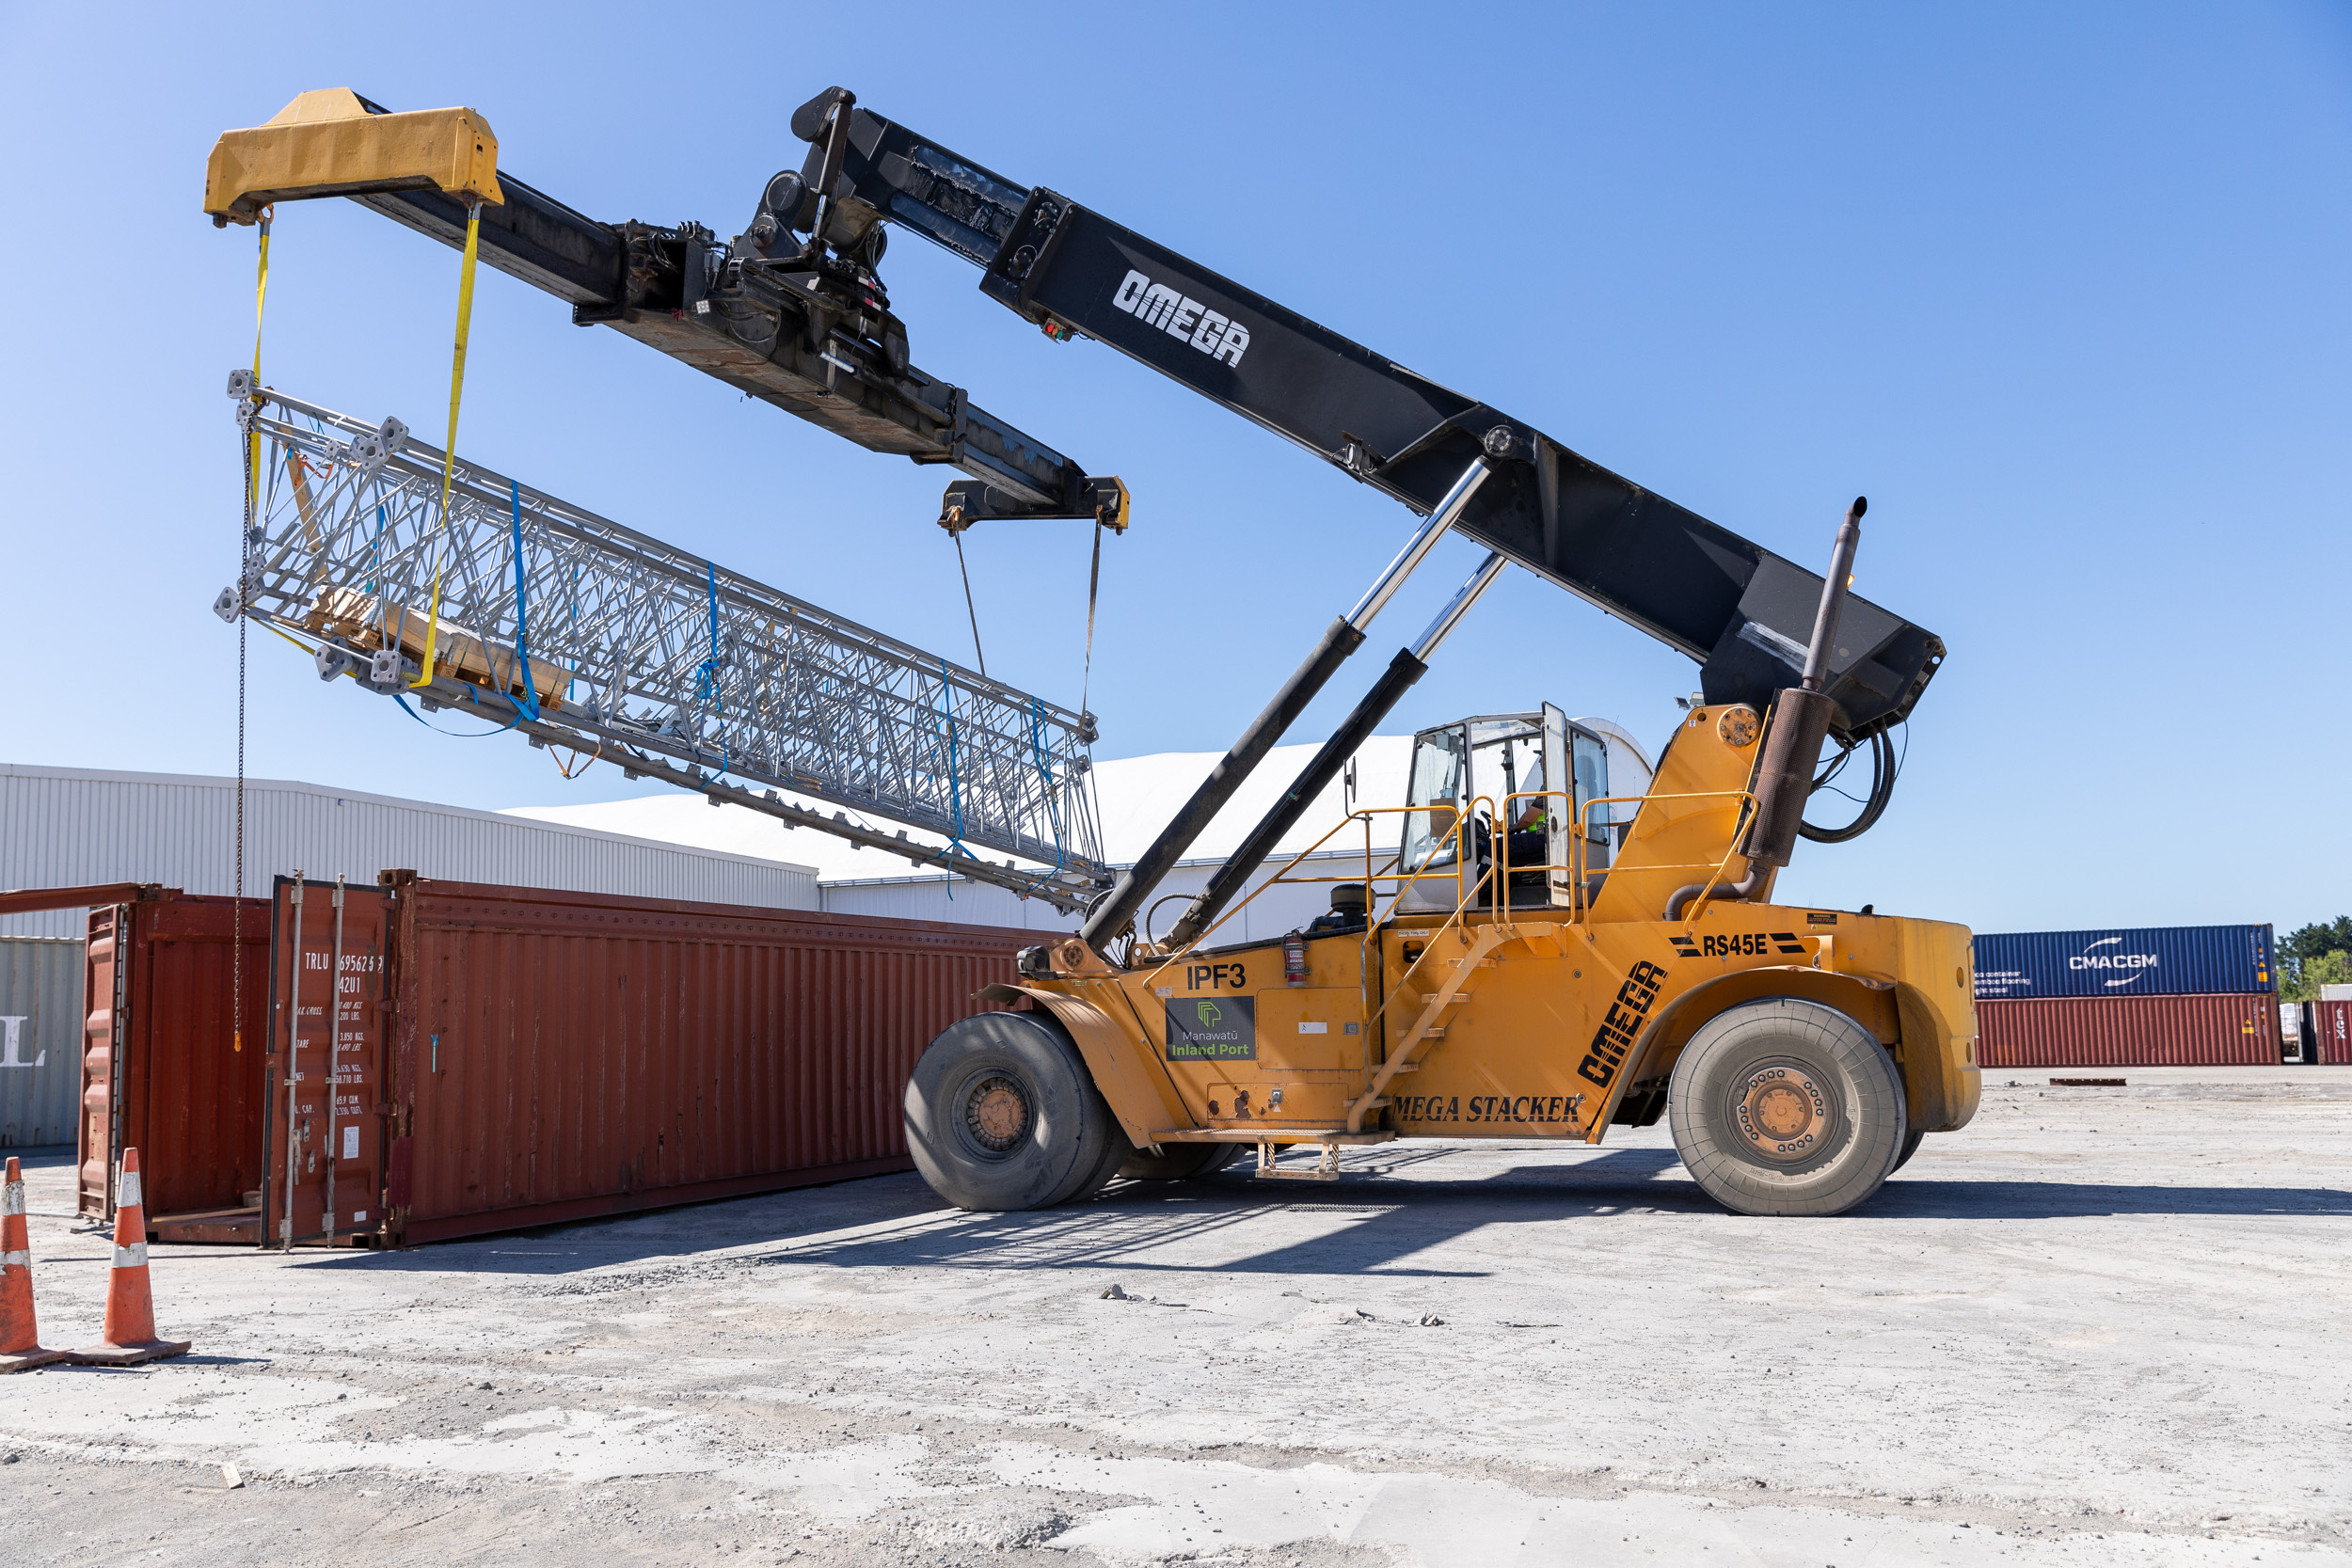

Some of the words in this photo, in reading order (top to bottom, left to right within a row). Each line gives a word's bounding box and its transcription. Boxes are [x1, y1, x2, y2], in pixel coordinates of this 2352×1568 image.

[1112, 269, 1250, 369] OMEGA
[1703, 933, 1768, 957] RS45E
[305, 952, 329, 970] TRLU
[1187, 963, 1247, 990] IPF3
[1183, 1030, 1238, 1041] Manawatū
[1577, 960, 1668, 1088] OMEGA
[1172, 1043, 1216, 1056] Inland
[1219, 1043, 1249, 1055] Port
[1467, 1096, 1581, 1123] STACKER
